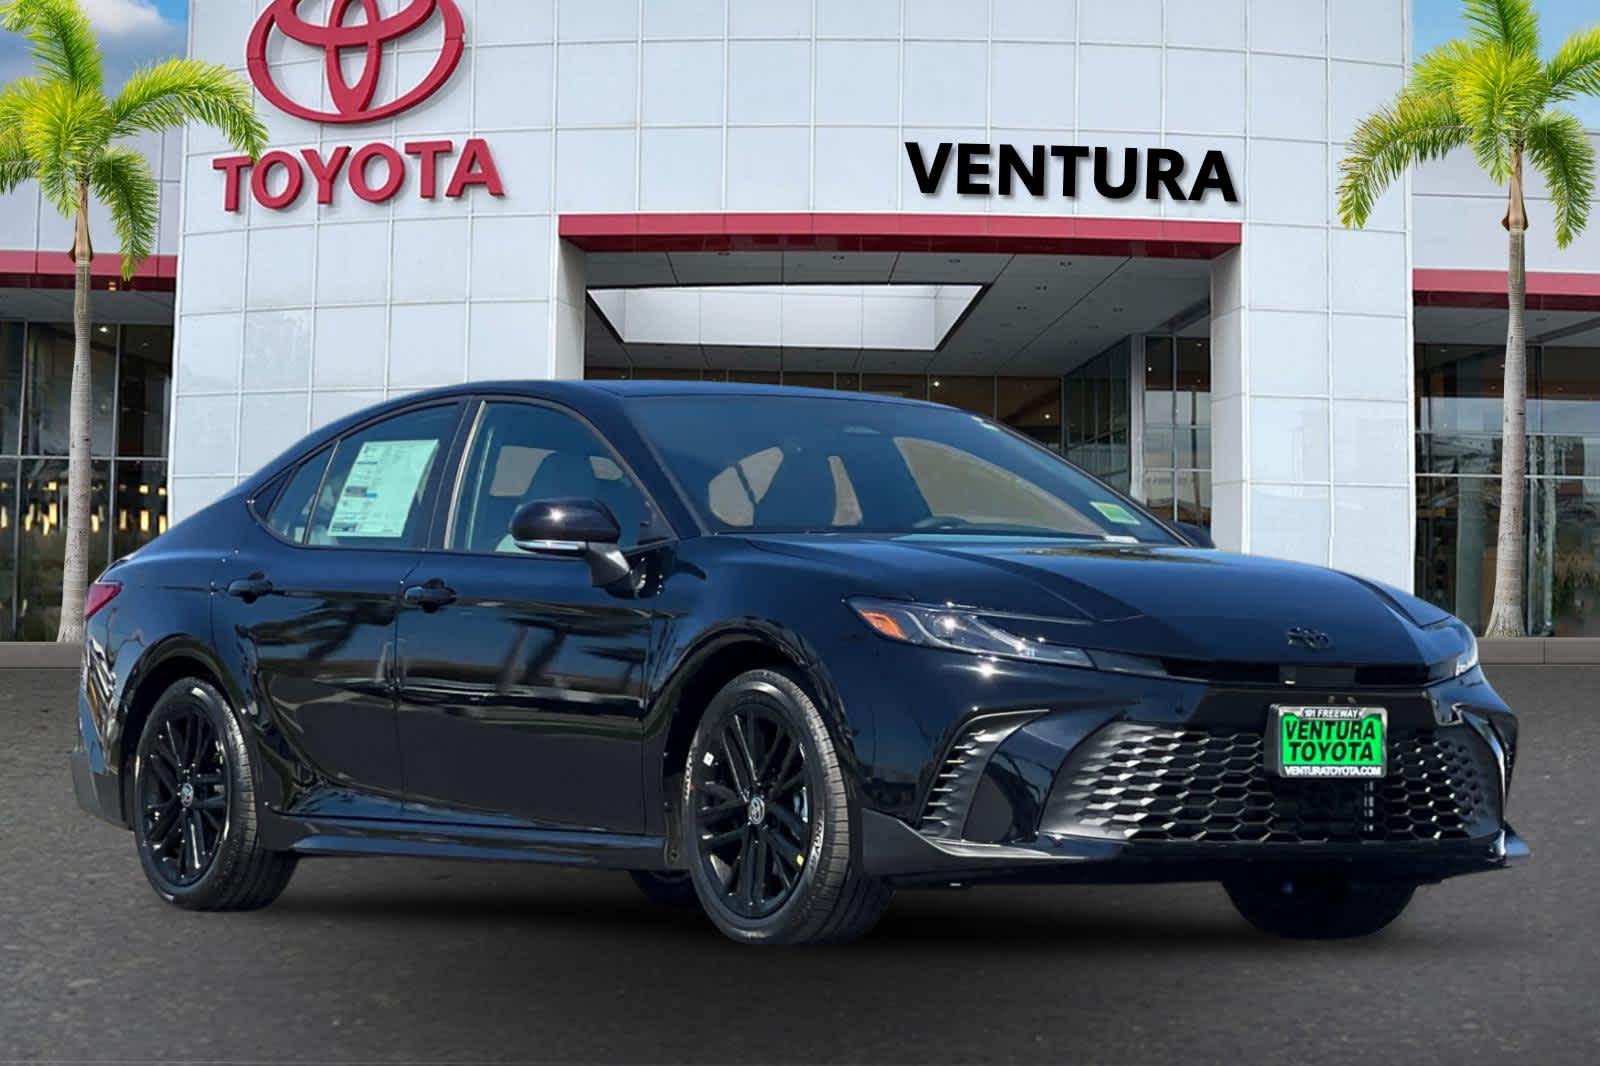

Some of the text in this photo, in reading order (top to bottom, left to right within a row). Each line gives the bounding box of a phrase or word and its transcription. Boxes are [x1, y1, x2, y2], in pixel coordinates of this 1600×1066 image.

[212, 138, 505, 213] TOYOTA
[904, 142, 1238, 202] VENTURA
[1317, 709, 1358, 719] FREEWAY
[1285, 721, 1375, 740] VENTURA
[1289, 741, 1374, 761] TOYOTA
[1284, 766, 1382, 776] VENTURATOYOTA.COM
